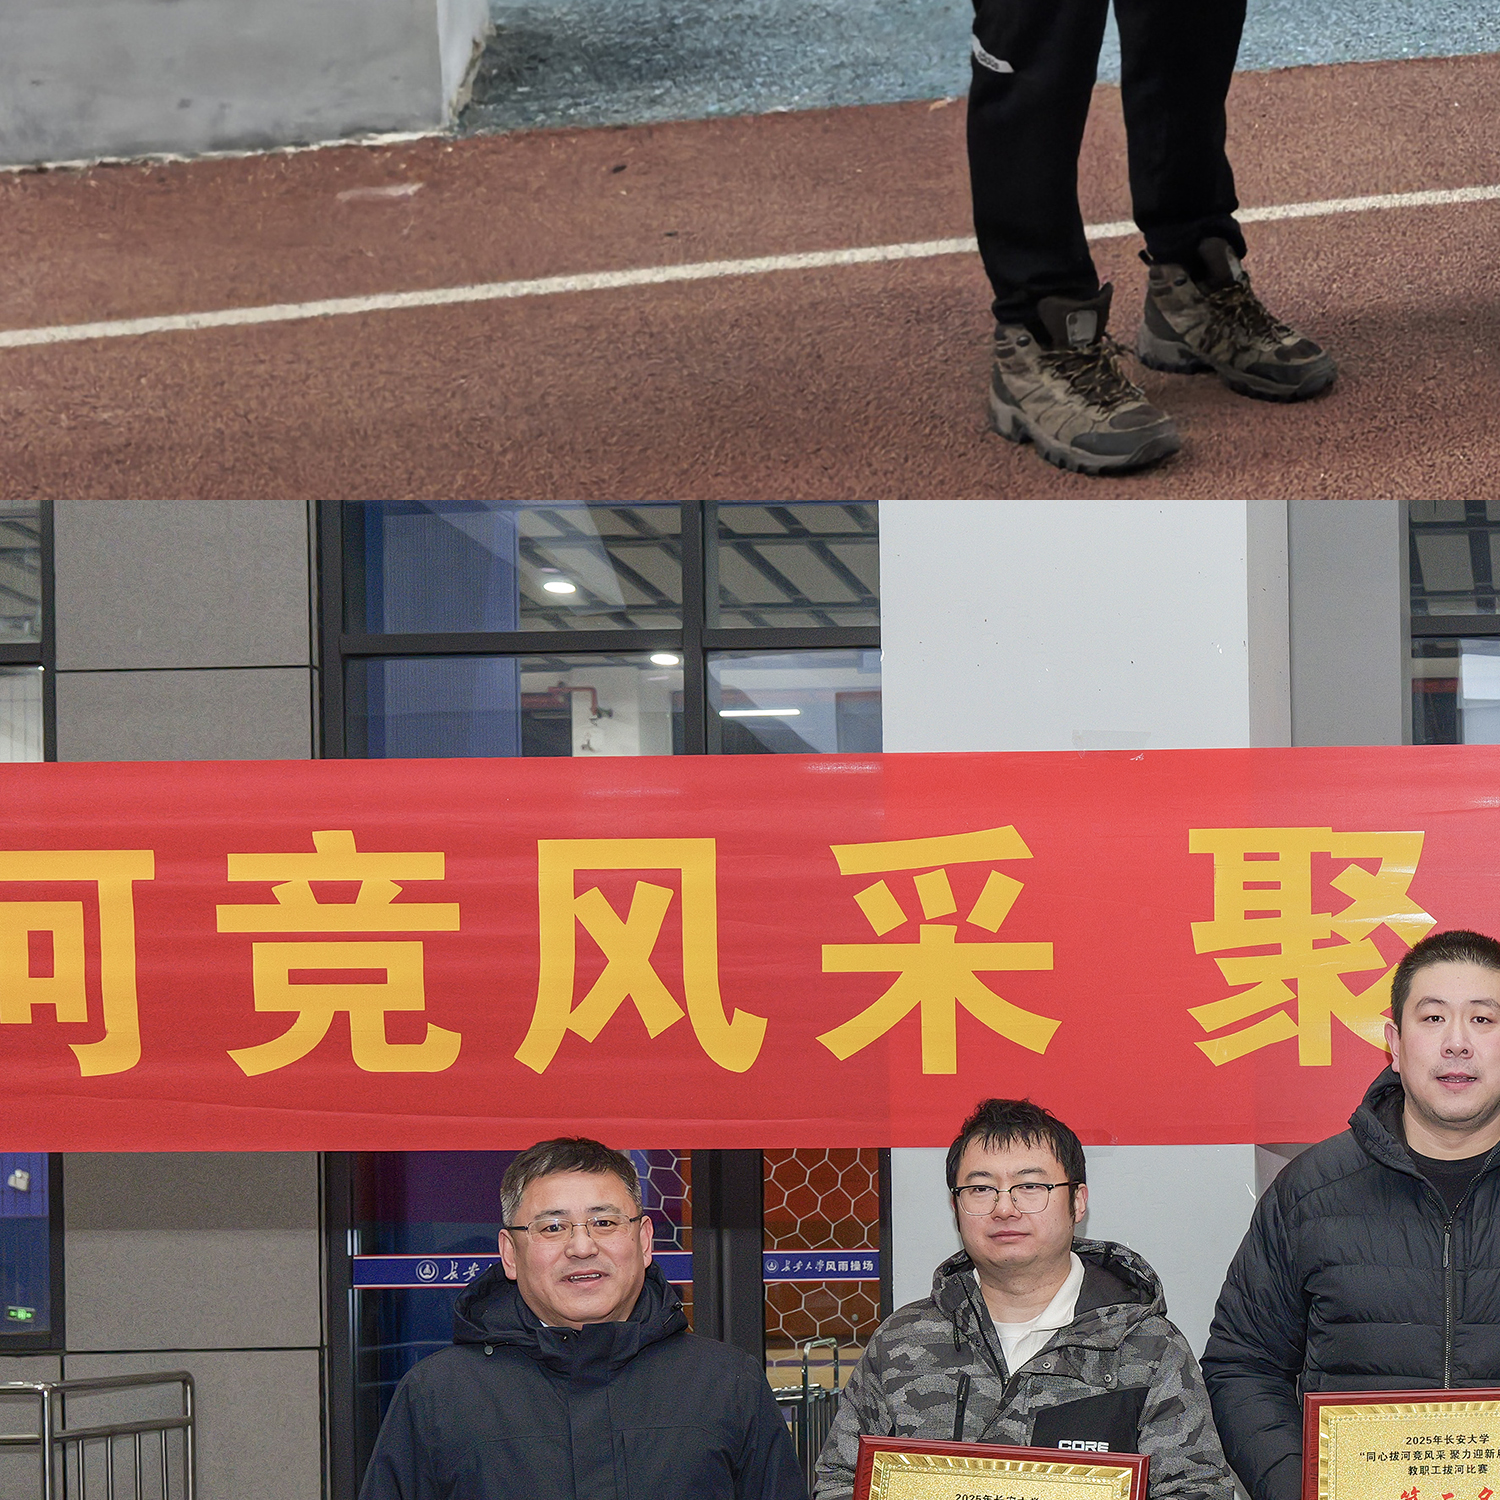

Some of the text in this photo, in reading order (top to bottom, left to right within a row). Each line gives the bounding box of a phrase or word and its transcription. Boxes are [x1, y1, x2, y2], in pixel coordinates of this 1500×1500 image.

[1058, 1439, 1109, 1452] CORE
[1405, 1433, 1490, 1446] 2025年长安大学
[1407, 1463, 1488, 1476] 教职工拔河比赛
